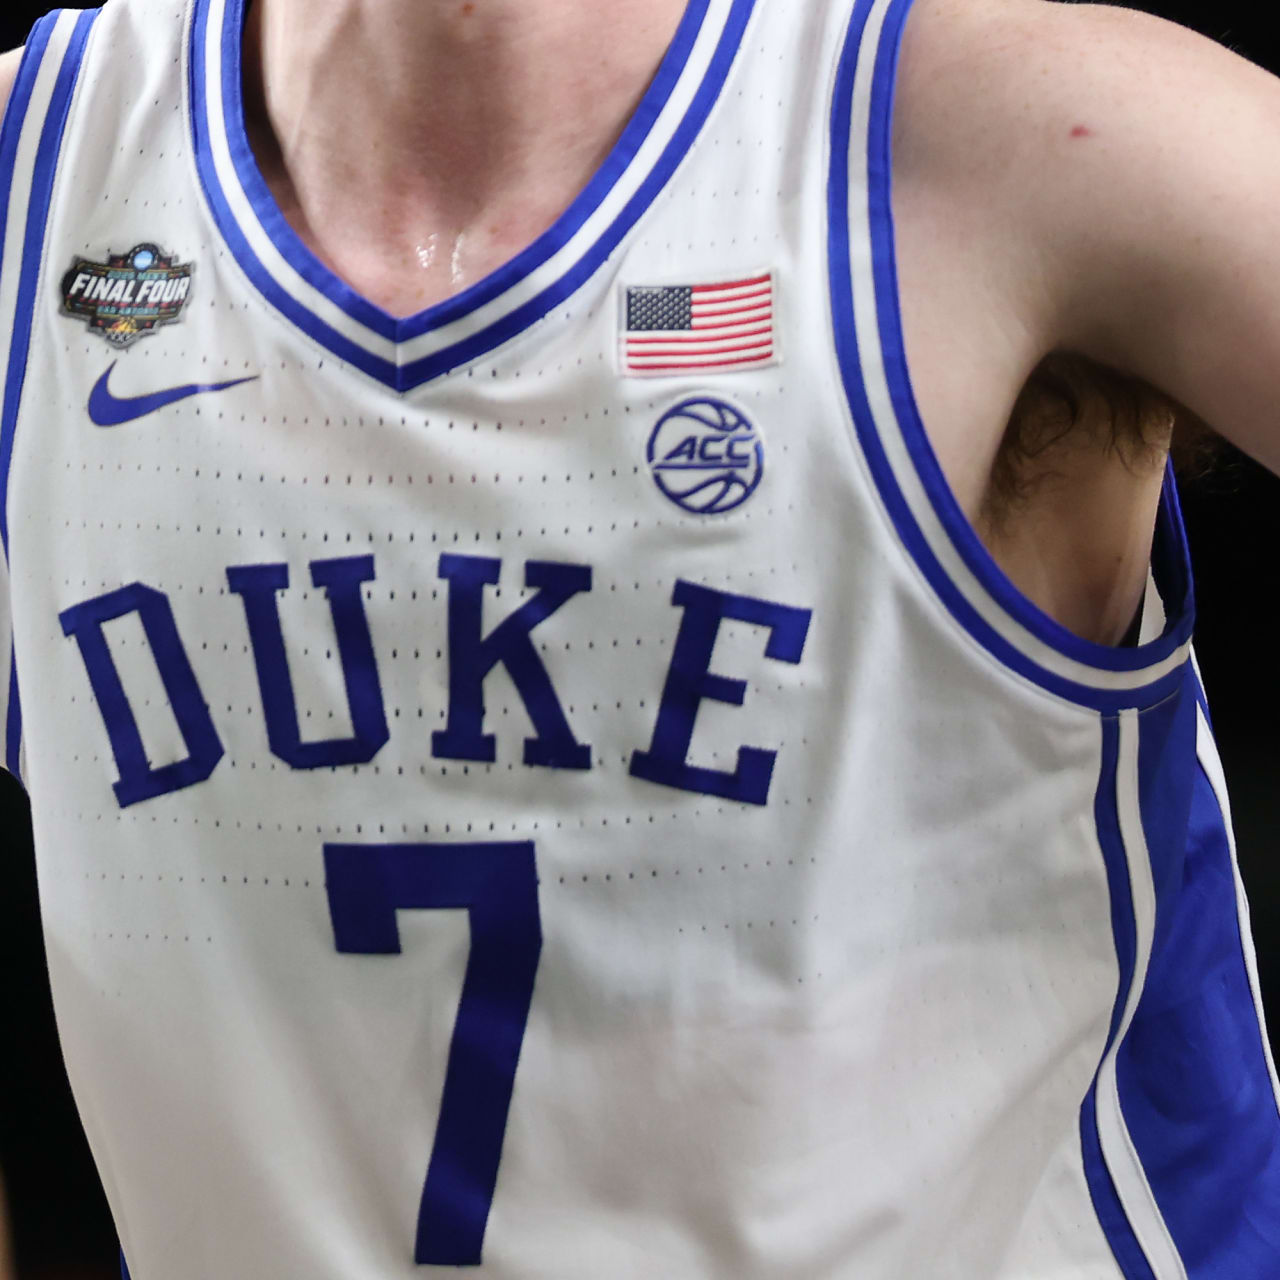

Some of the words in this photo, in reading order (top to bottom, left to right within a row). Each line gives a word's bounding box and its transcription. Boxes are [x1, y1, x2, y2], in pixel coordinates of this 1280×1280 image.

[69, 272, 137, 303] FINAL
[135, 275, 191, 303] FOUR
[663, 434, 756, 461] ACC
[58, 552, 812, 808] DUKE
[323, 839, 543, 1266] 7
